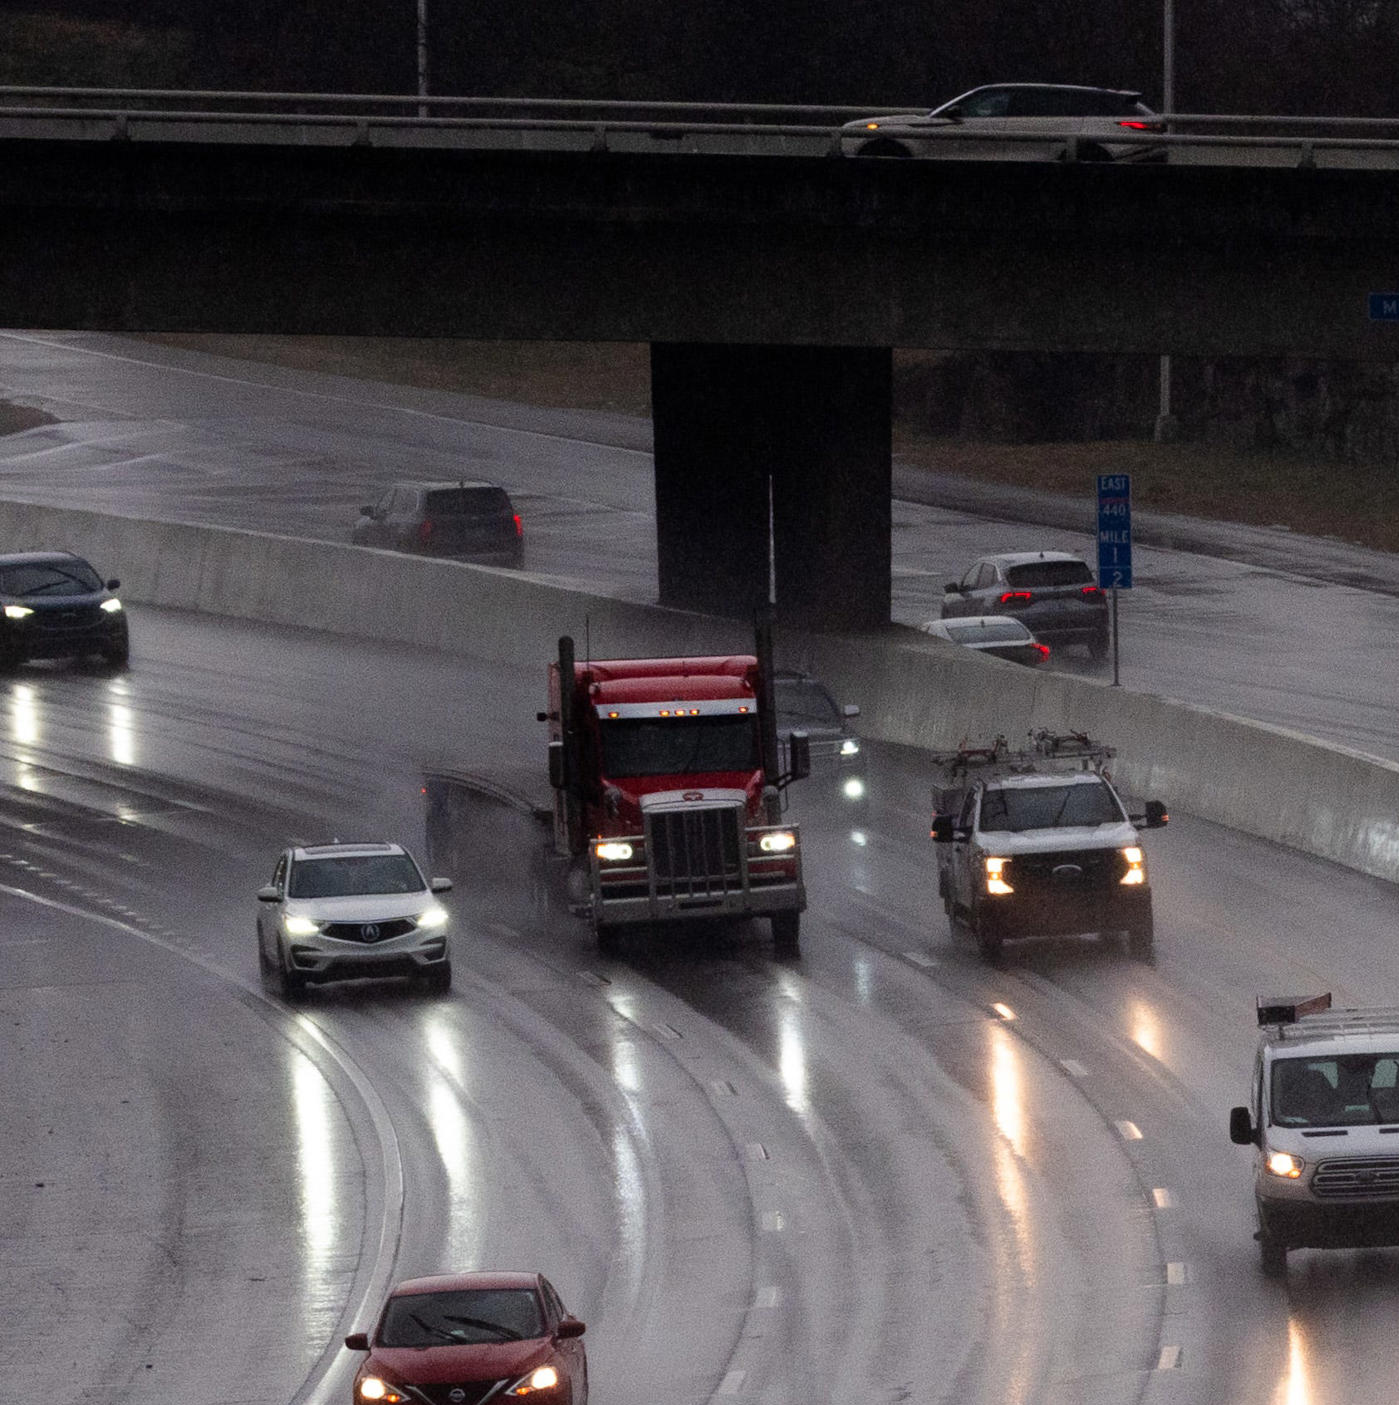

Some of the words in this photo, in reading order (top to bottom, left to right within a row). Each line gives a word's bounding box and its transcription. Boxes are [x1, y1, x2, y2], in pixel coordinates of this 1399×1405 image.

[1101, 477, 1127, 490] EAST
[1103, 503, 1126, 517] 440
[1100, 530, 1128, 544] MILE
[1112, 570, 1123, 587] 2
